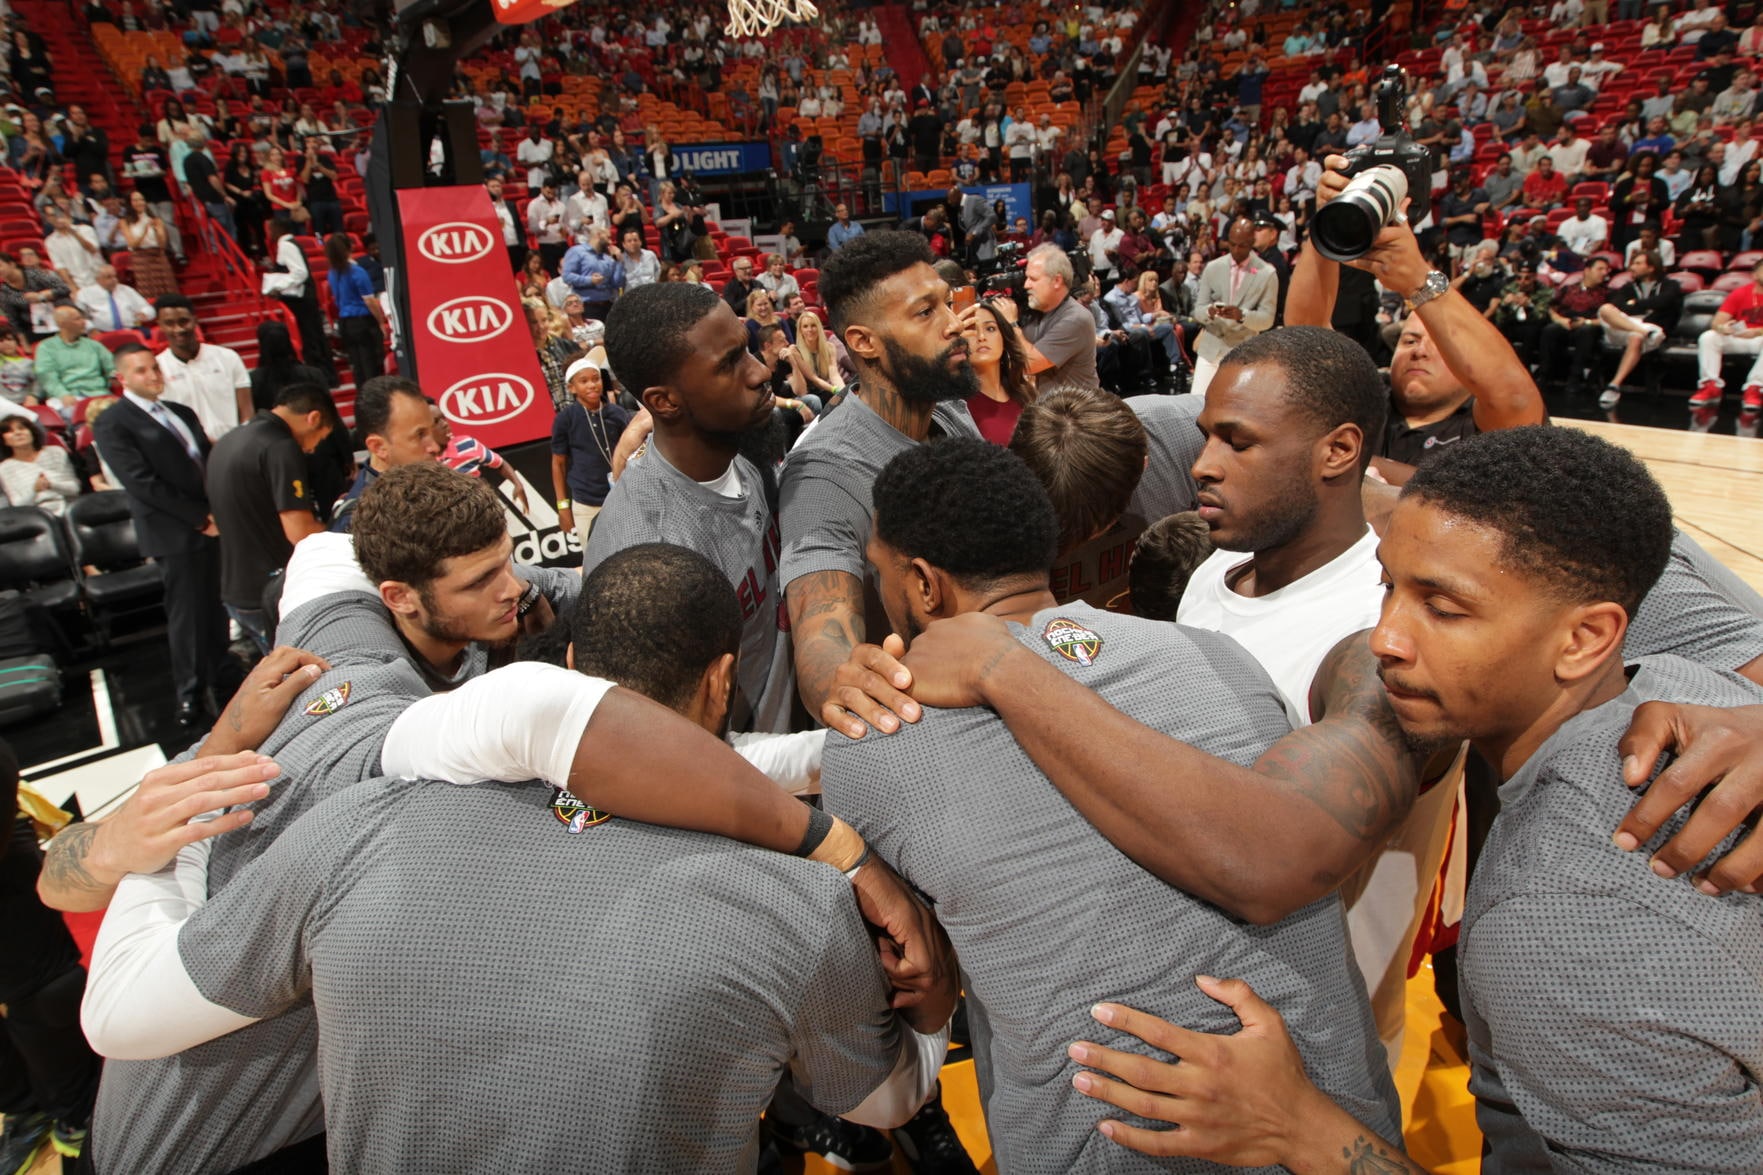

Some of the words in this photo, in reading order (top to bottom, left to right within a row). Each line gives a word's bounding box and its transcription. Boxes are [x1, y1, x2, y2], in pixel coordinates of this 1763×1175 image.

[682, 150, 739, 171] LIGHT
[430, 230, 483, 257] KIA
[441, 305, 501, 335] KIA
[454, 382, 522, 418] KIA
[512, 527, 583, 566] das
[736, 566, 767, 621] EL
